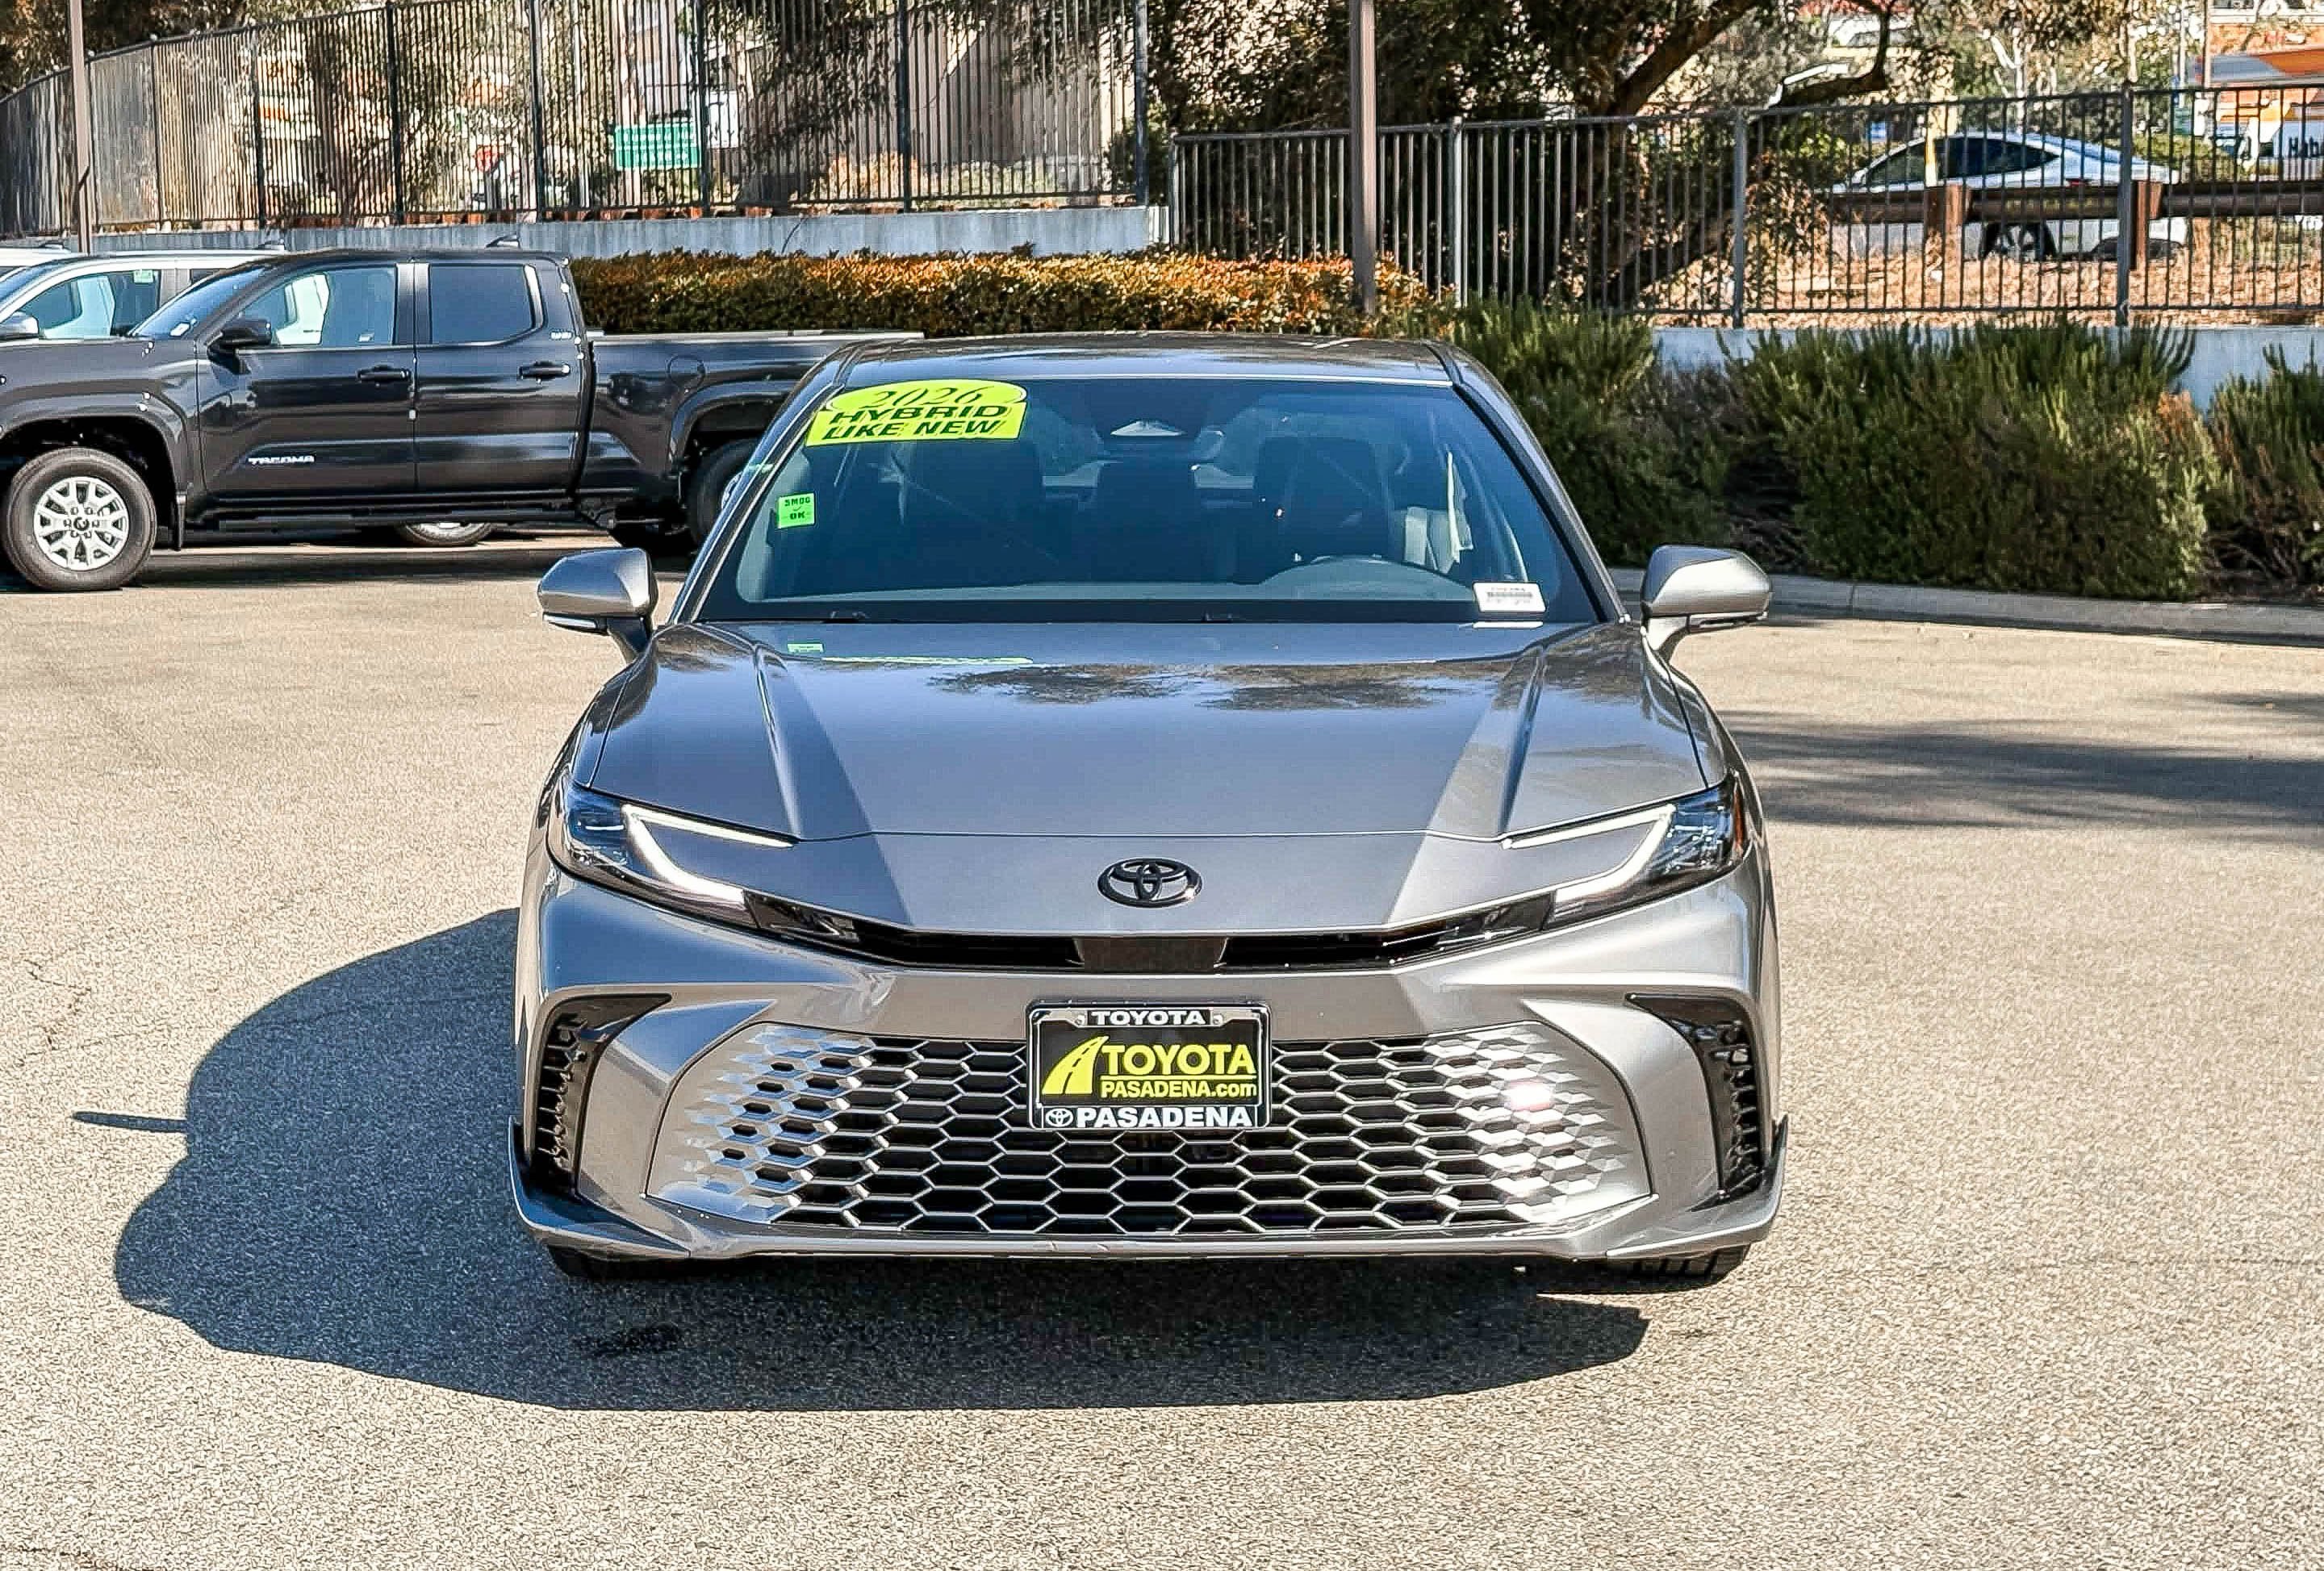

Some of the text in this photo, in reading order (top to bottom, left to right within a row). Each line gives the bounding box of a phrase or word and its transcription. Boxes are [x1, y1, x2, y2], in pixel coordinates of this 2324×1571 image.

[859, 386, 994, 408] 2026
[830, 405, 1007, 424] HYBRID
[822, 420, 1001, 440] LIKE NEW
[249, 455, 315, 465] TACOMA
[789, 512, 805, 520] OK
[1091, 1010, 1206, 1026] TOYOTA
[1101, 1044, 1256, 1075] TOYOTA
[1102, 1080, 1257, 1098] PASADENA.com
[1077, 1107, 1253, 1127] PASADENA
